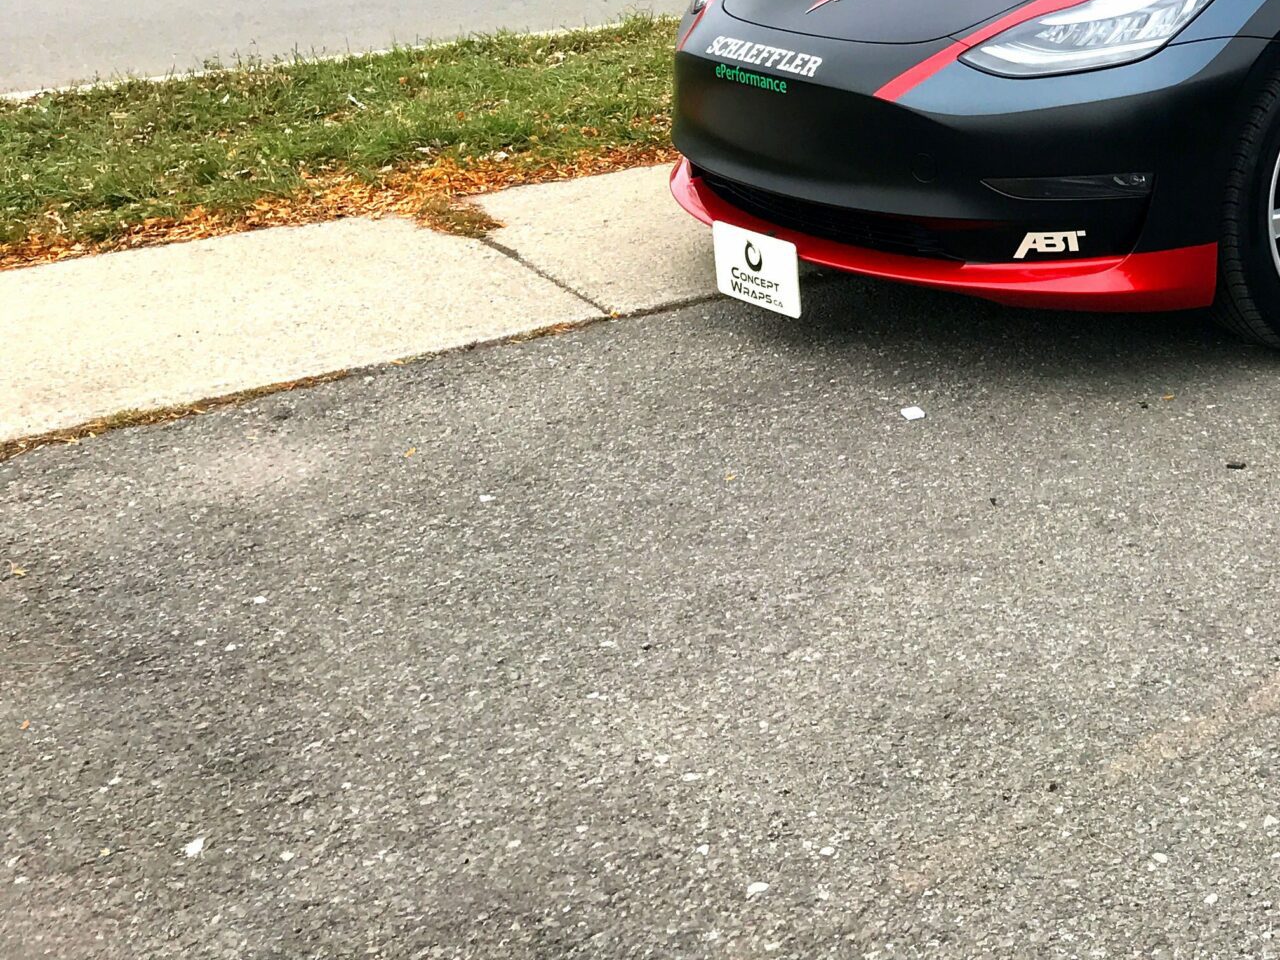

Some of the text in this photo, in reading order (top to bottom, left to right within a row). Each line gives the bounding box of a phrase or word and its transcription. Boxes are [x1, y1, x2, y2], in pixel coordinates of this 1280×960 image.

[705, 35, 823, 78] SCHAEFFLER
[715, 63, 787, 94] ePerformance
[1012, 229, 1087, 259] ABT
[731, 266, 780, 292] CONCEPT
